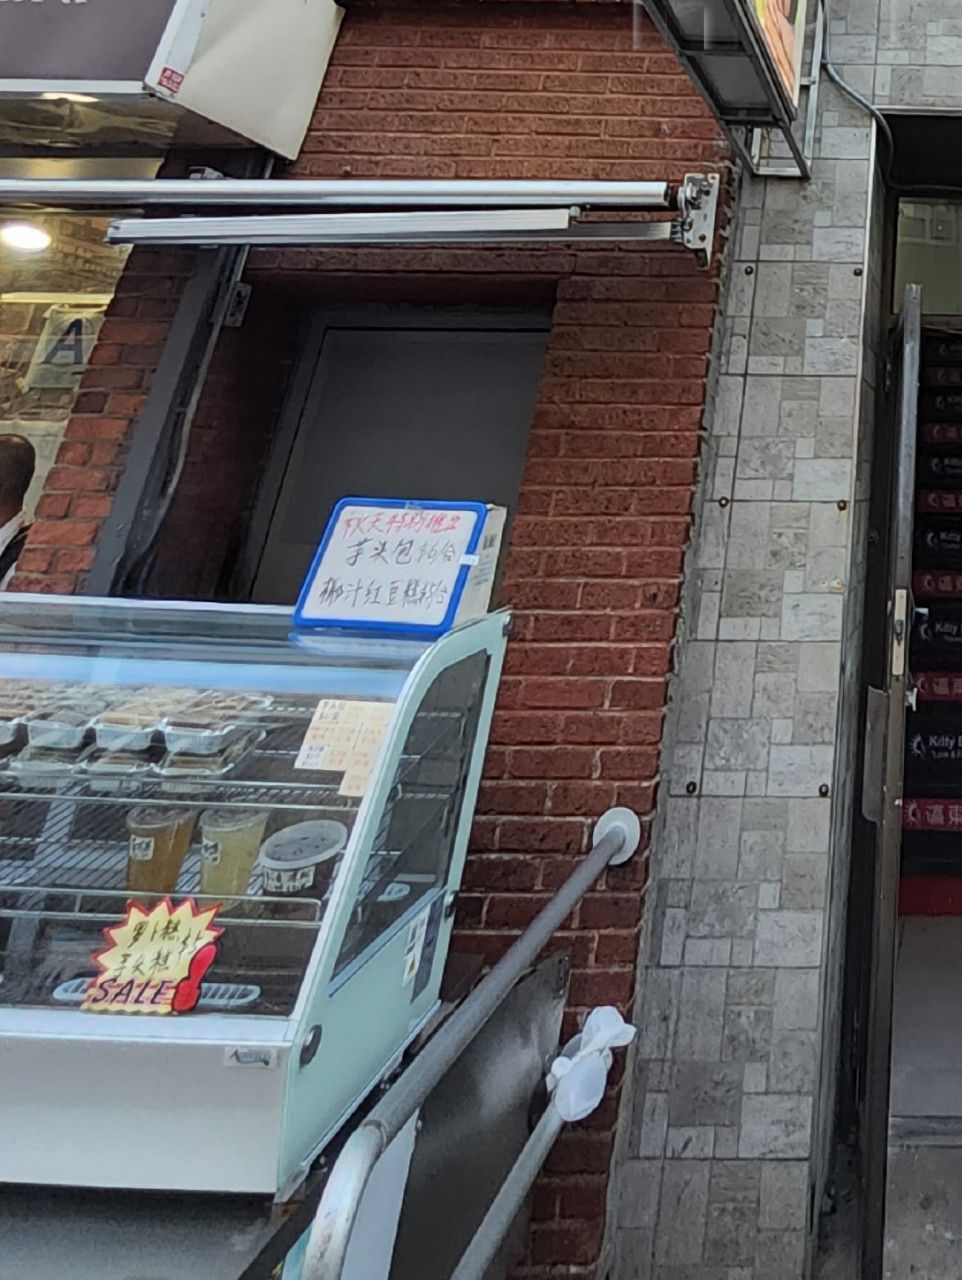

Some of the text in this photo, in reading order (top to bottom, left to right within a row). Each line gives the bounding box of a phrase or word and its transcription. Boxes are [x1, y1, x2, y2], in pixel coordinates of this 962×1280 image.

[42, 319, 83, 364] A
[929, 735, 955, 750] Kitty
[91, 977, 174, 1006] SALE
